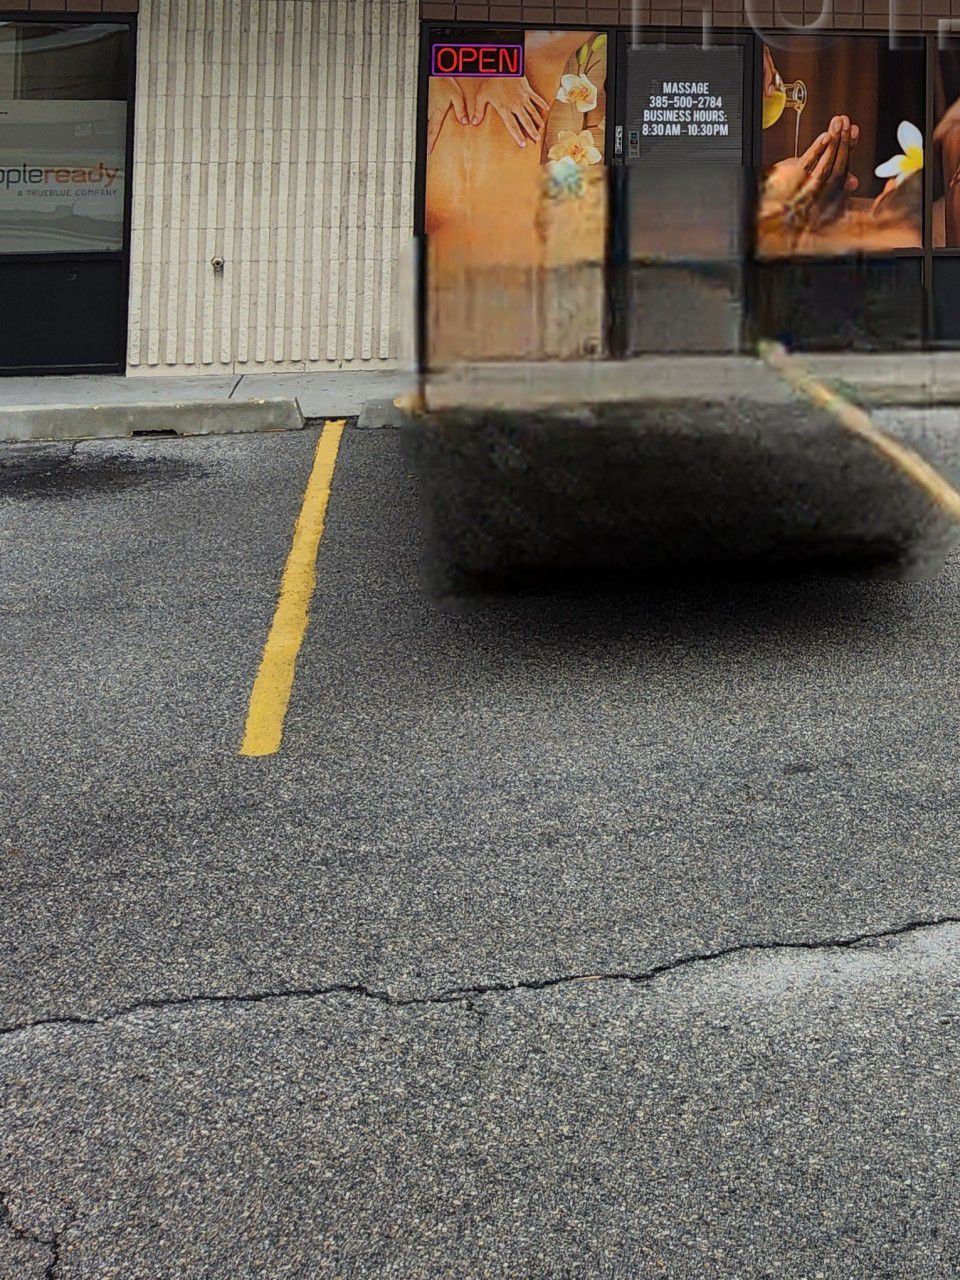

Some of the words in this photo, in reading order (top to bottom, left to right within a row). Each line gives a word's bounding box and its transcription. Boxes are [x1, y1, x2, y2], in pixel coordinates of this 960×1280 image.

[437, 48, 517, 72] OPEN
[663, 82, 709, 94] MASSAGE
[649, 96, 722, 108] 385-500-2784
[643, 110, 691, 122] BUSINESS
[694, 111, 728, 122] HOURS:
[27, 189, 72, 197] TRUEBLUE
[75, 189, 118, 197] COMPANY
